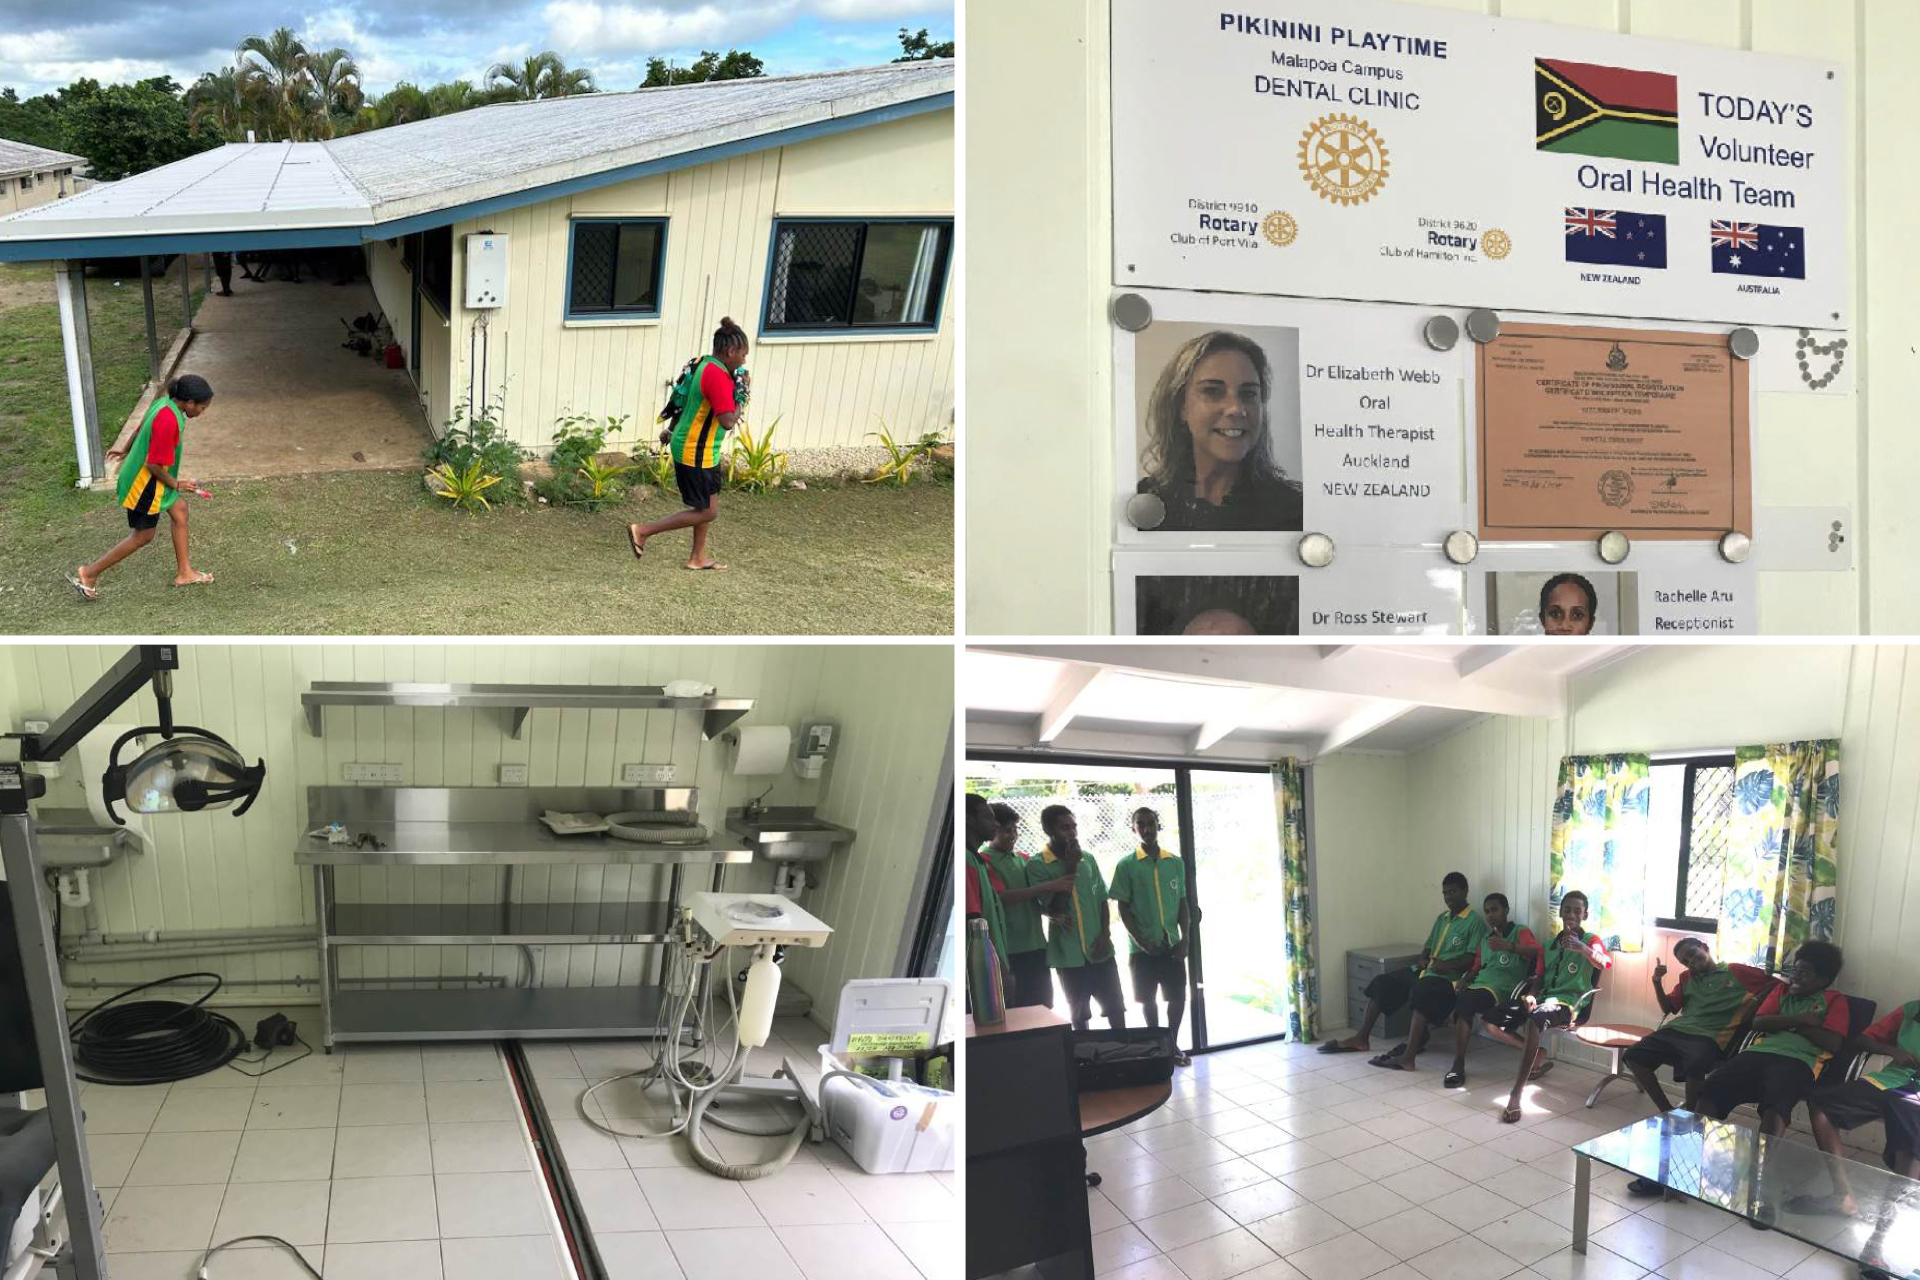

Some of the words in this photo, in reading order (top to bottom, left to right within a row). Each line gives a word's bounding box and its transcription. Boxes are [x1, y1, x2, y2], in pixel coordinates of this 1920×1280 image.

[1220, 13, 1321, 43] PIKININI
[1331, 27, 1448, 59] PLAYTIME
[1342, 60, 1404, 81] Campus
[1255, 75, 1342, 103] DENTAL
[1349, 87, 1420, 110] CLINIC
[1699, 92, 1813, 128] TODAY'S
[1700, 135, 1815, 169] Volunteer
[1577, 165, 1632, 193] Oral
[1642, 171, 1722, 202] Health
[1730, 180, 1795, 208] Team
[1188, 199, 1227, 210] District
[1200, 214, 1258, 235] Rotary
[1170, 233, 1196, 245] Club
[1428, 231, 1477, 251] Rotary
[1380, 246, 1402, 257] Club
[1404, 248, 1414, 257] of
[1580, 273, 1600, 283] NEW
[1602, 274, 1641, 286] ZEALAND
[1736, 284, 1781, 296] AUSTRALIA
[1306, 364, 1324, 379] Dr
[1328, 366, 1394, 382] Elizabeth
[1399, 369, 1440, 384] Webb
[1360, 396, 1390, 410] Oral
[1315, 424, 1363, 438] Health
[1368, 425, 1435, 442] Therapist
[1343, 454, 1410, 469] Auckland
[1323, 483, 1358, 497] NEW
[1363, 483, 1431, 498] ZEALAND
[1655, 590, 1707, 602] Rachelle
[1312, 611, 1330, 625] Dr
[1334, 612, 1367, 625] Ross
[1371, 612, 1428, 625] Stewart
[1656, 616, 1735, 631] Receptionist
